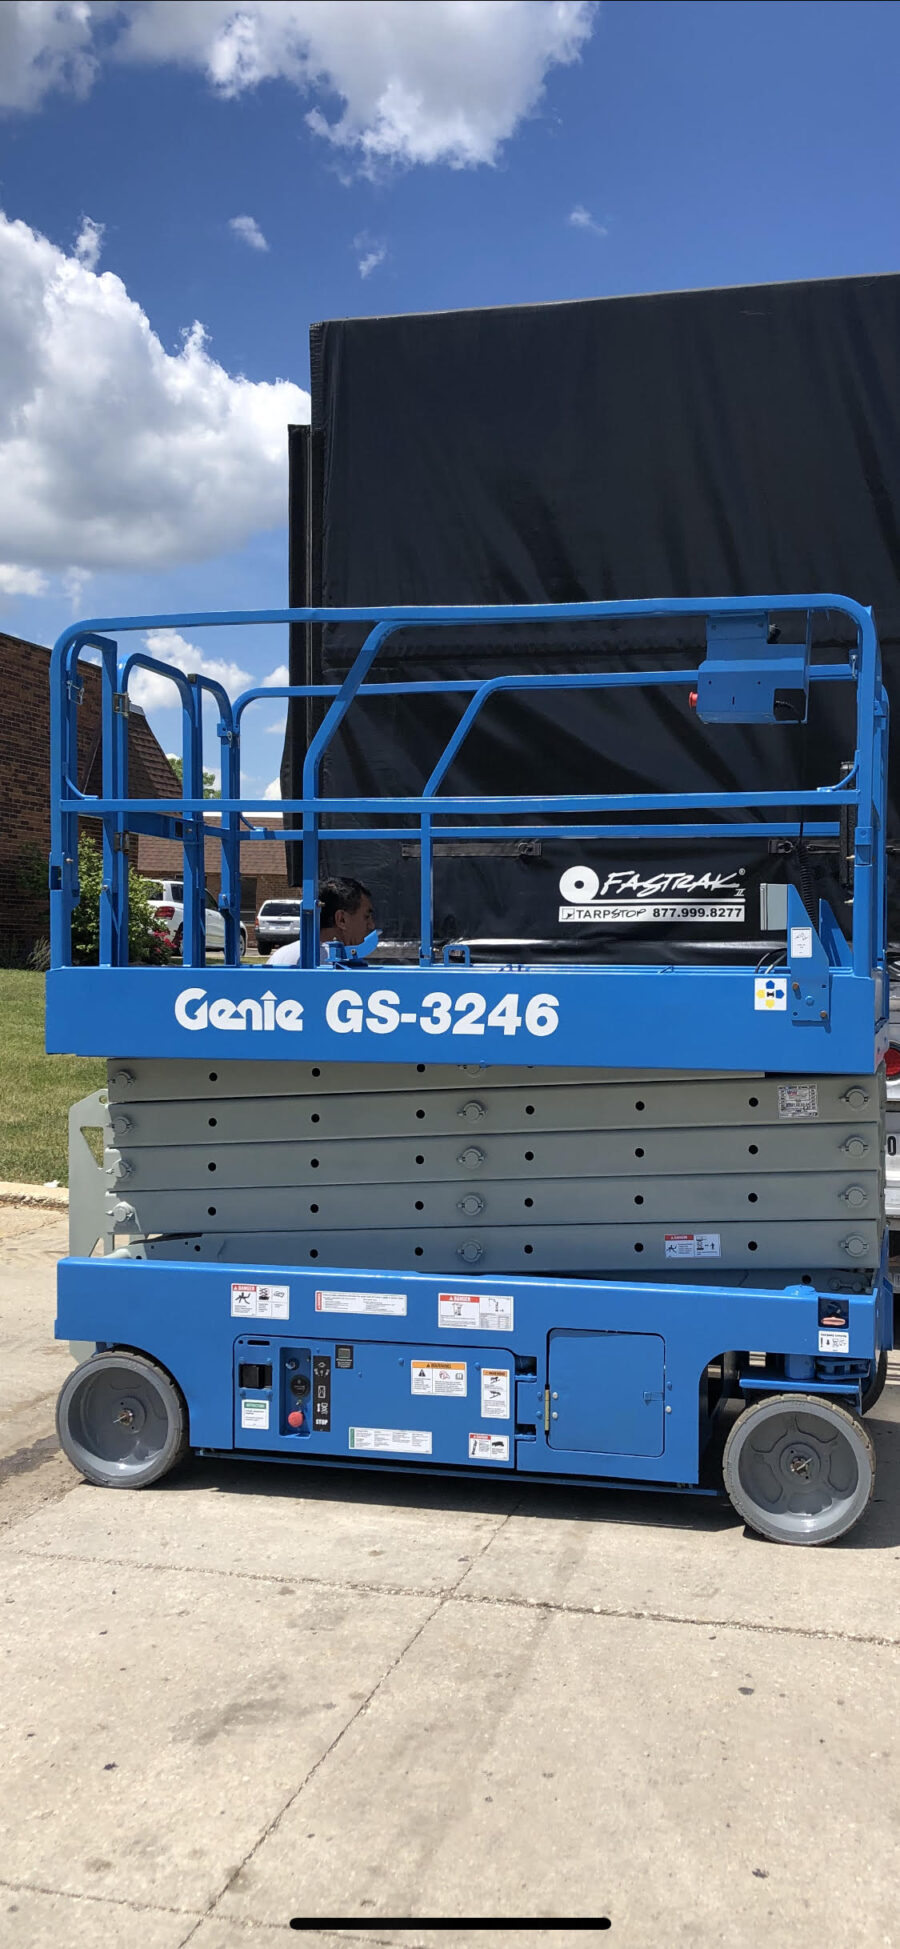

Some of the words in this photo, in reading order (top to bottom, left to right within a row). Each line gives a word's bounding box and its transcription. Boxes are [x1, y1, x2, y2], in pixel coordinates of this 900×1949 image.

[576, 908, 647, 919] TARPSTOP
[652, 907, 742, 918] 877.999.8277
[174, 987, 304, 1031] Genie
[325, 989, 560, 1037] GS-3246
[315, 1418, 329, 1426] STOP
